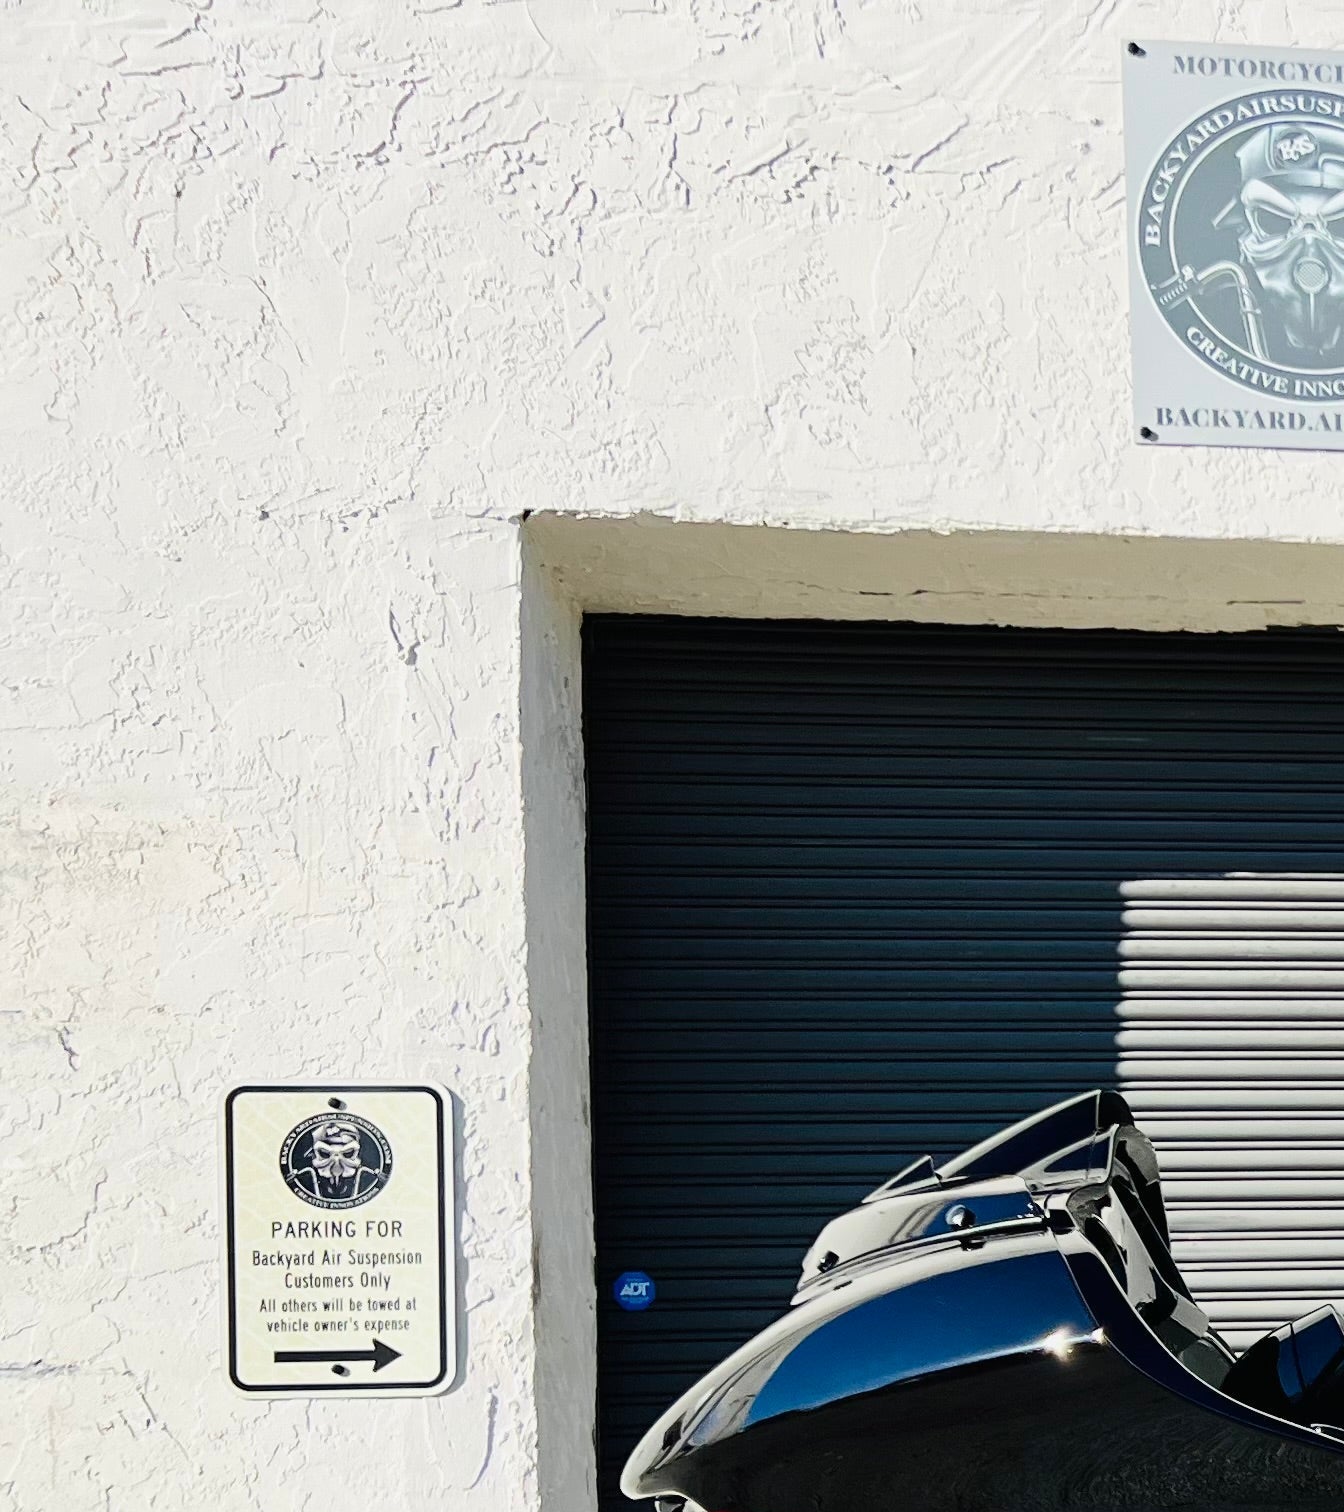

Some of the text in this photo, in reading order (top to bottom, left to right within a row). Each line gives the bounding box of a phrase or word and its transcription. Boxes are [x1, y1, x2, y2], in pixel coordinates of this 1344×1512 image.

[1185, 326, 1289, 396] CREATIVE
[271, 1220, 403, 1239] PARKING FOR
[252, 1248, 422, 1269] Backyard Air Suspension
[284, 1272, 391, 1291] Customers Only
[620, 1281, 650, 1296] ADT
[259, 1297, 417, 1313] All others will be towed at
[266, 1319, 411, 1333] vehicle owner's expense
